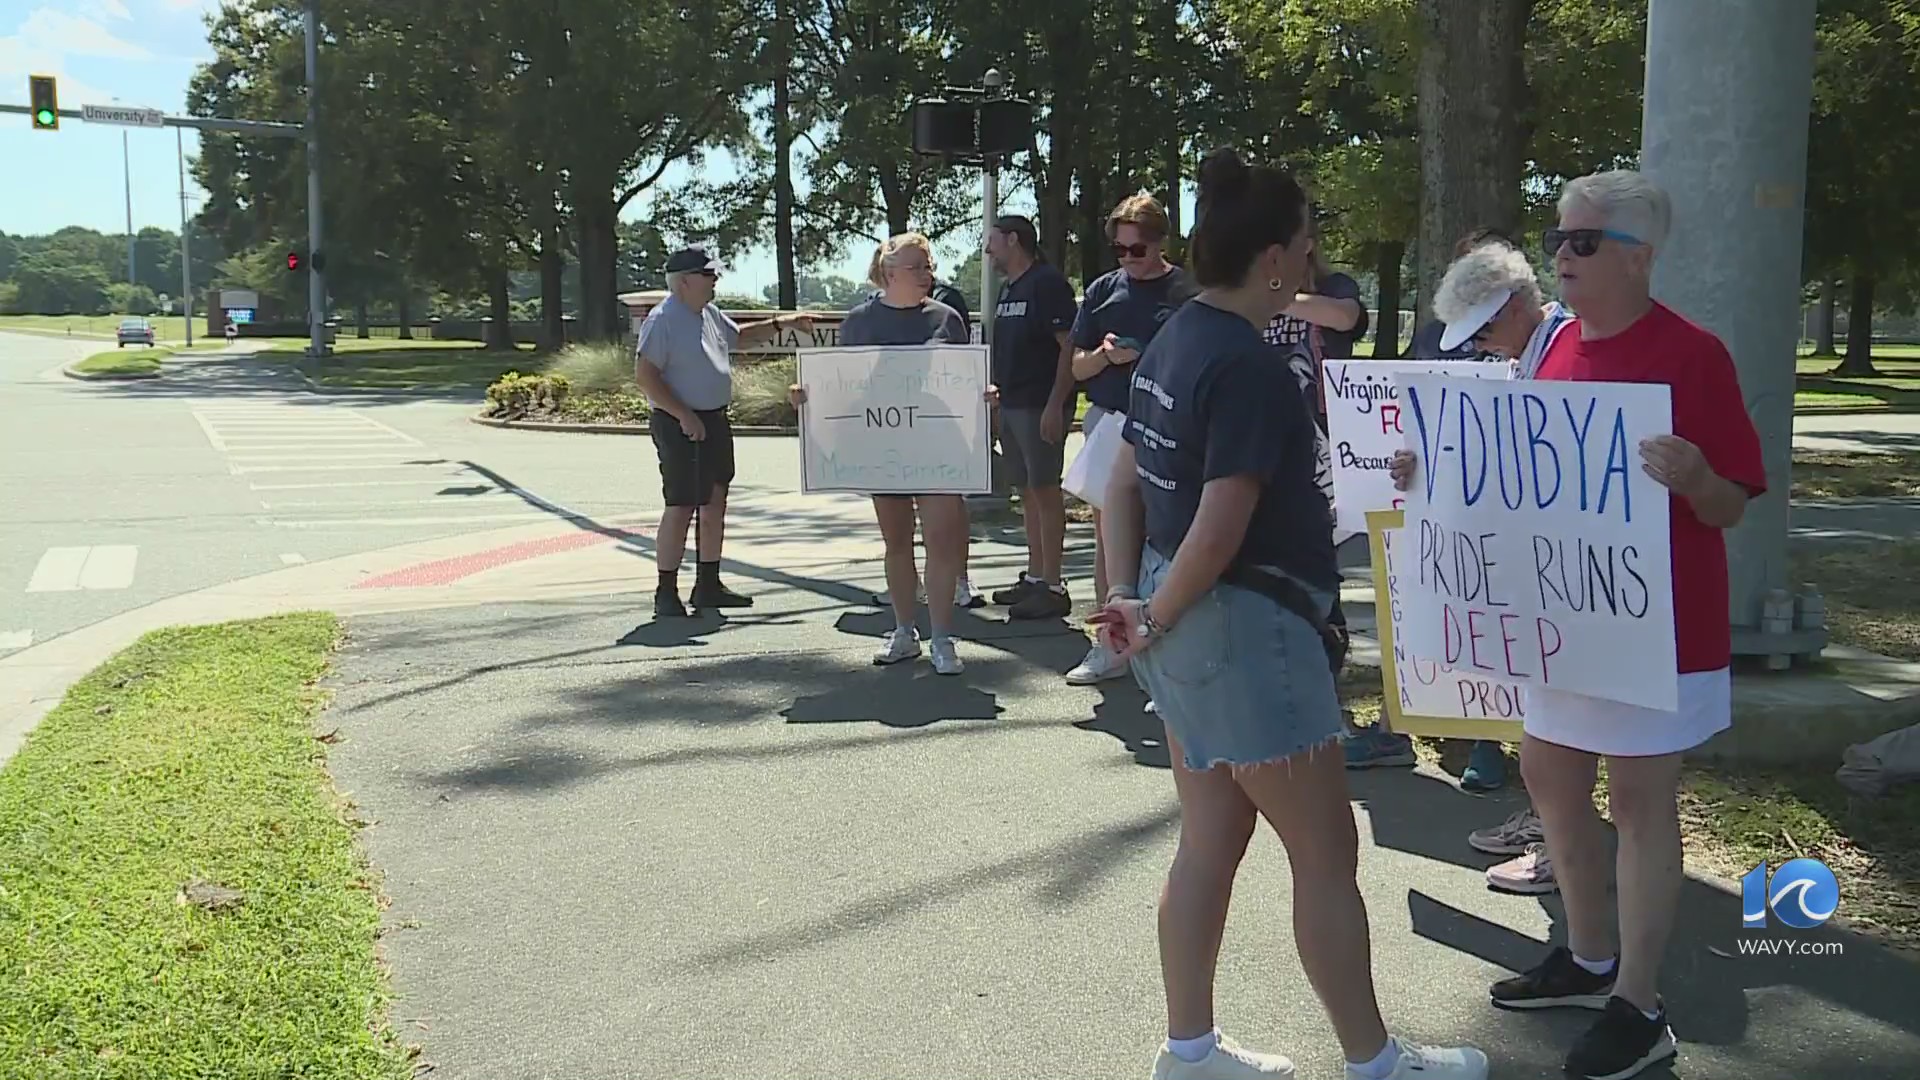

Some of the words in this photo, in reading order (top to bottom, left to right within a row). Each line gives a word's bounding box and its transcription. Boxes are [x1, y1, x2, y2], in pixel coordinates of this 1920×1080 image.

[86, 107, 144, 124] University
[866, 405, 919, 428] NOT
[1408, 386, 1631, 522] V-DUBYA
[1420, 518, 1509, 606] PRIDE
[1533, 535, 1648, 618] RUNS
[1444, 603, 1561, 683] DEEP
